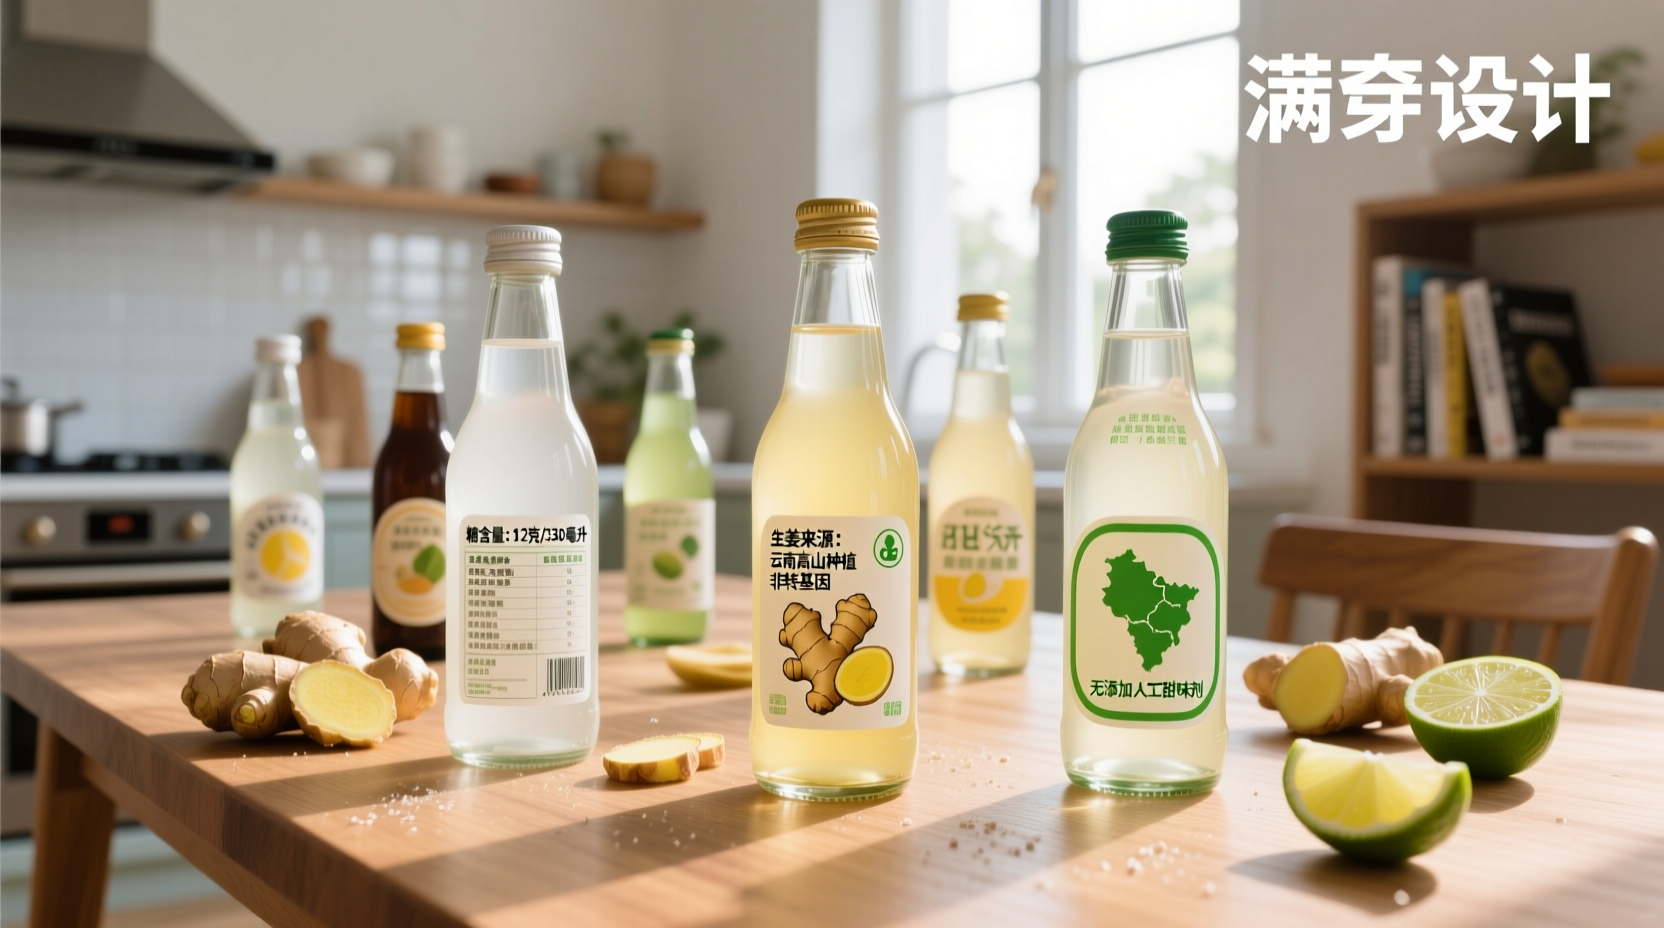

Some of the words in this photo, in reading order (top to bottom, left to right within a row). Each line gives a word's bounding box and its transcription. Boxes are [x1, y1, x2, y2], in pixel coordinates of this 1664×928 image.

[770, 550, 857, 570] 云南高山种植
